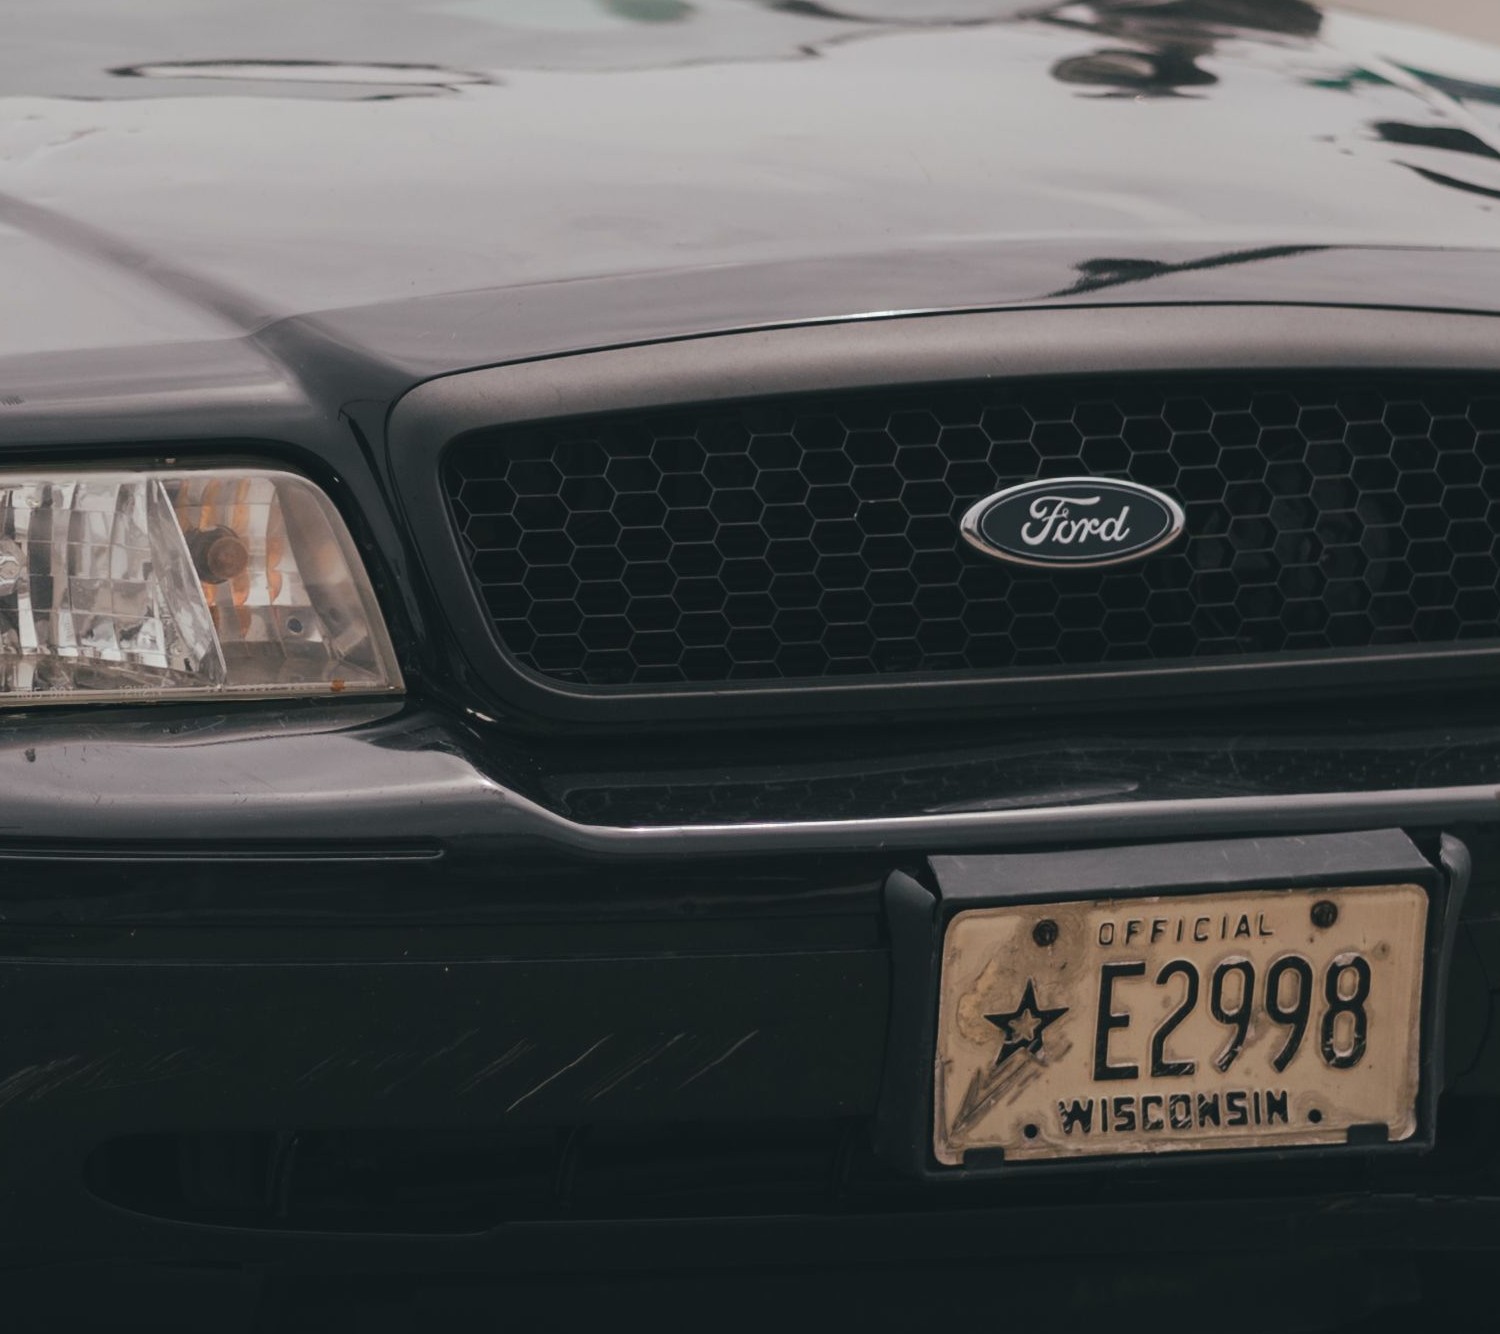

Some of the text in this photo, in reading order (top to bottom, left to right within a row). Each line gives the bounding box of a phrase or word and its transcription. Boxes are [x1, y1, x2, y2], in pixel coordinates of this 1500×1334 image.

[1021, 496, 1130, 545] Ford
[1098, 913, 1275, 948] OFFICIAL
[1093, 954, 1371, 1081] E2998
[1058, 1089, 1290, 1135] WISCONSIN
